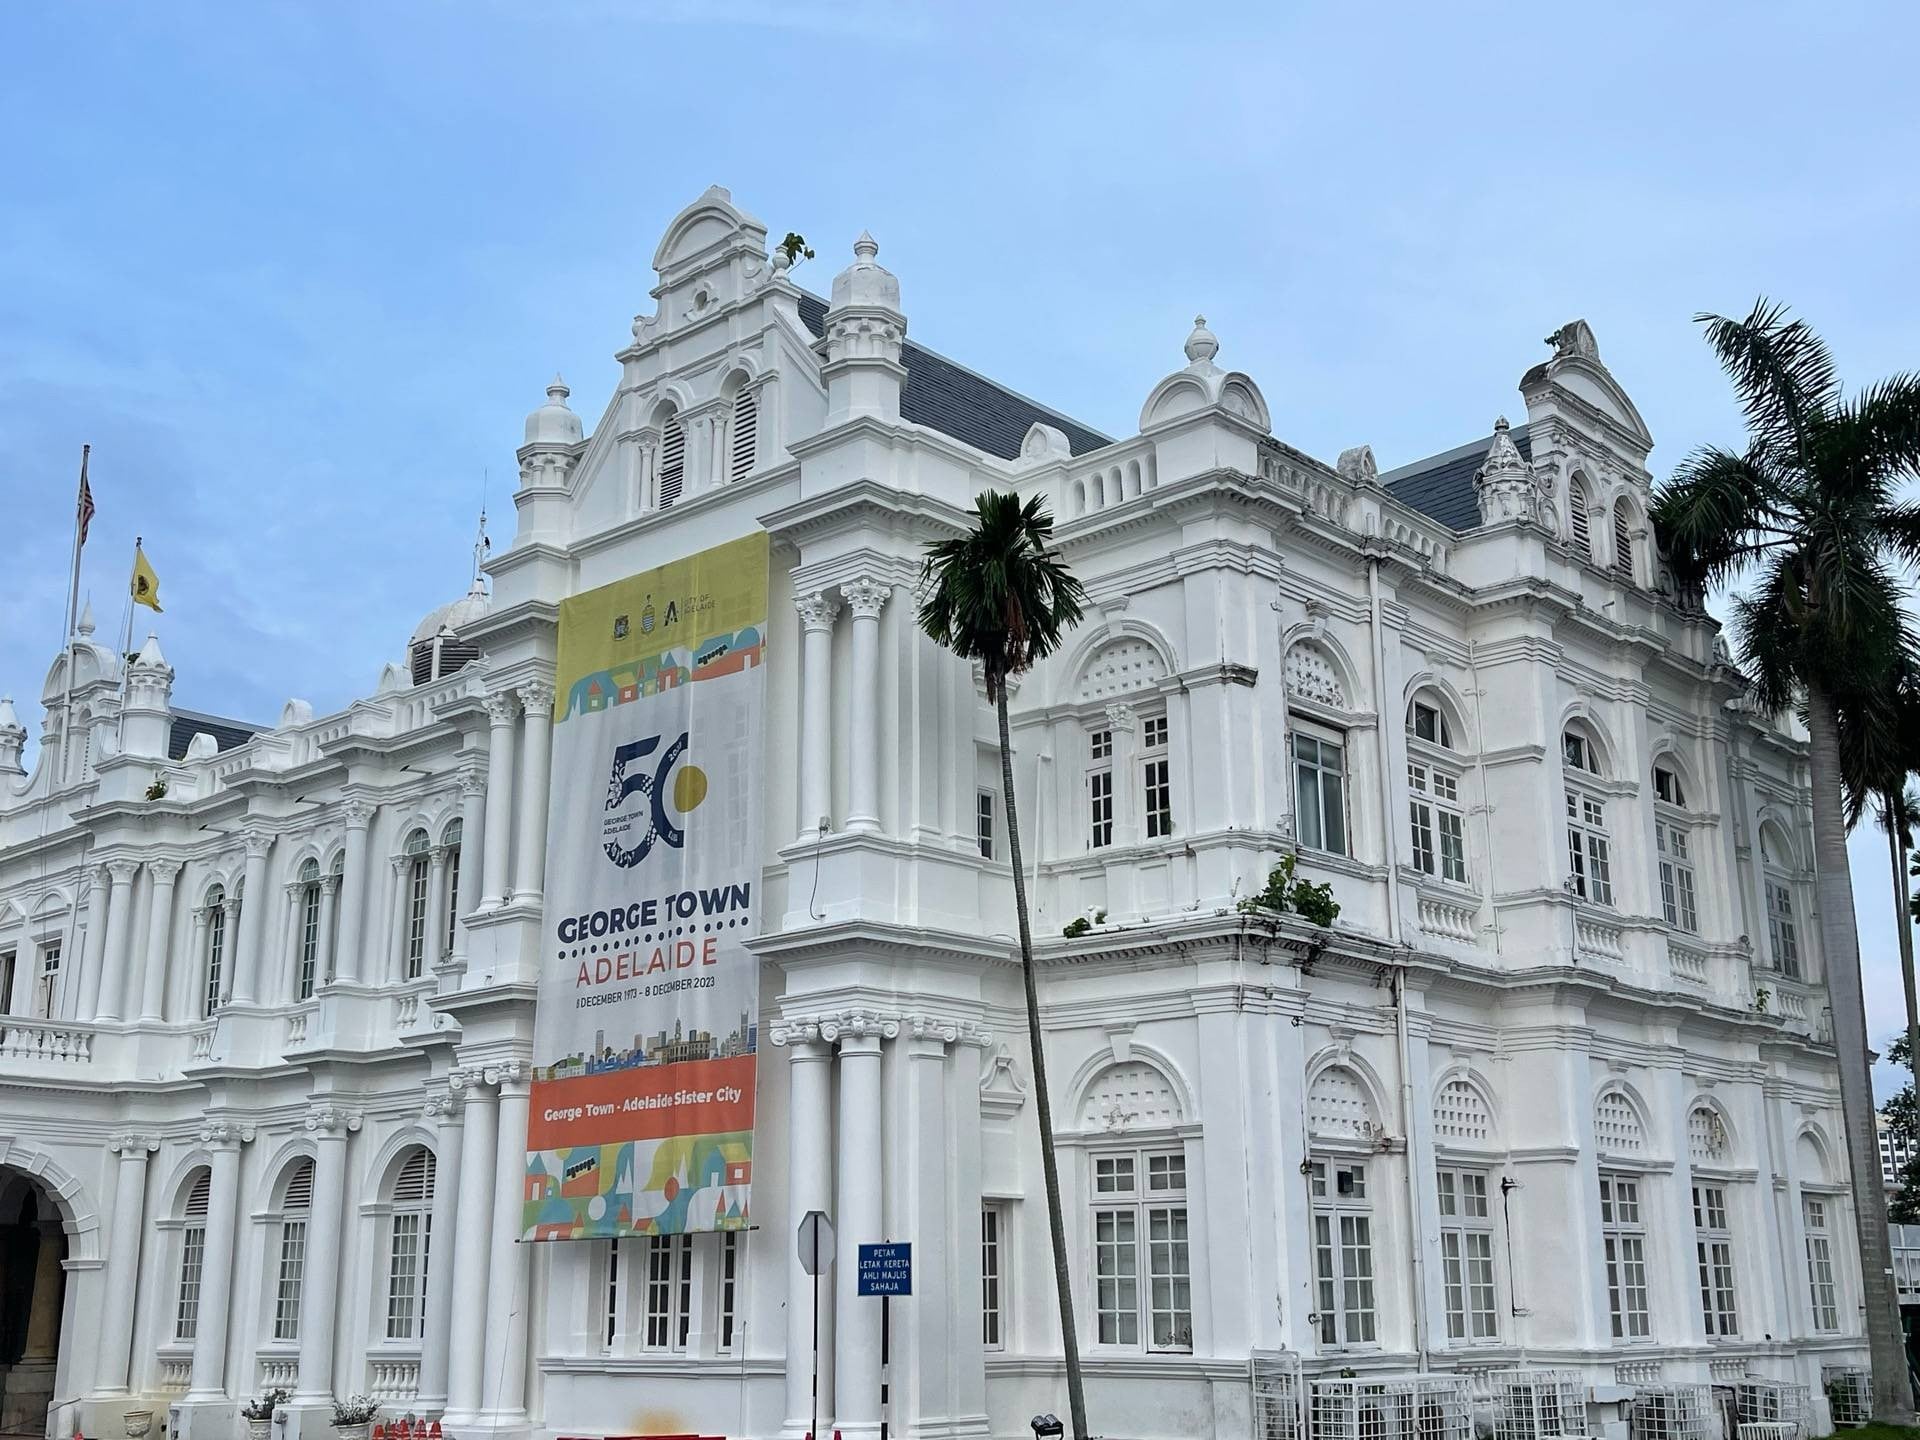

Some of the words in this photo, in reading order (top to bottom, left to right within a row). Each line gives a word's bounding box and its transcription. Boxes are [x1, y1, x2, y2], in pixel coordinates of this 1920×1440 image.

[603, 814, 628, 826] GEORGE
[603, 823, 632, 835] ADELAIDE
[557, 900, 657, 943] GEORGE
[665, 882, 750, 922] TOWN
[576, 938, 718, 988] ADELAIDE
[580, 991, 622, 1008] DECEMBER
[623, 988, 637, 1001] 1973
[645, 986, 650, 996] 8
[653, 978, 692, 996] DECEMBER
[694, 976, 715, 988] 2023
[544, 1107, 582, 1121] George
[585, 1104, 614, 1117] Town
[623, 1094, 673, 1112] Adelaide
[674, 1090, 713, 1105] Sister
[716, 1086, 742, 1103] City
[873, 1248, 896, 1257] PETAK
[860, 1260, 881, 1269] LETAK
[883, 1259, 910, 1269] KERETA
[863, 1271, 880, 1280] AHLI
[881, 1270, 907, 1279] MAJLIS
[870, 1281, 899, 1291] SAHAJA
